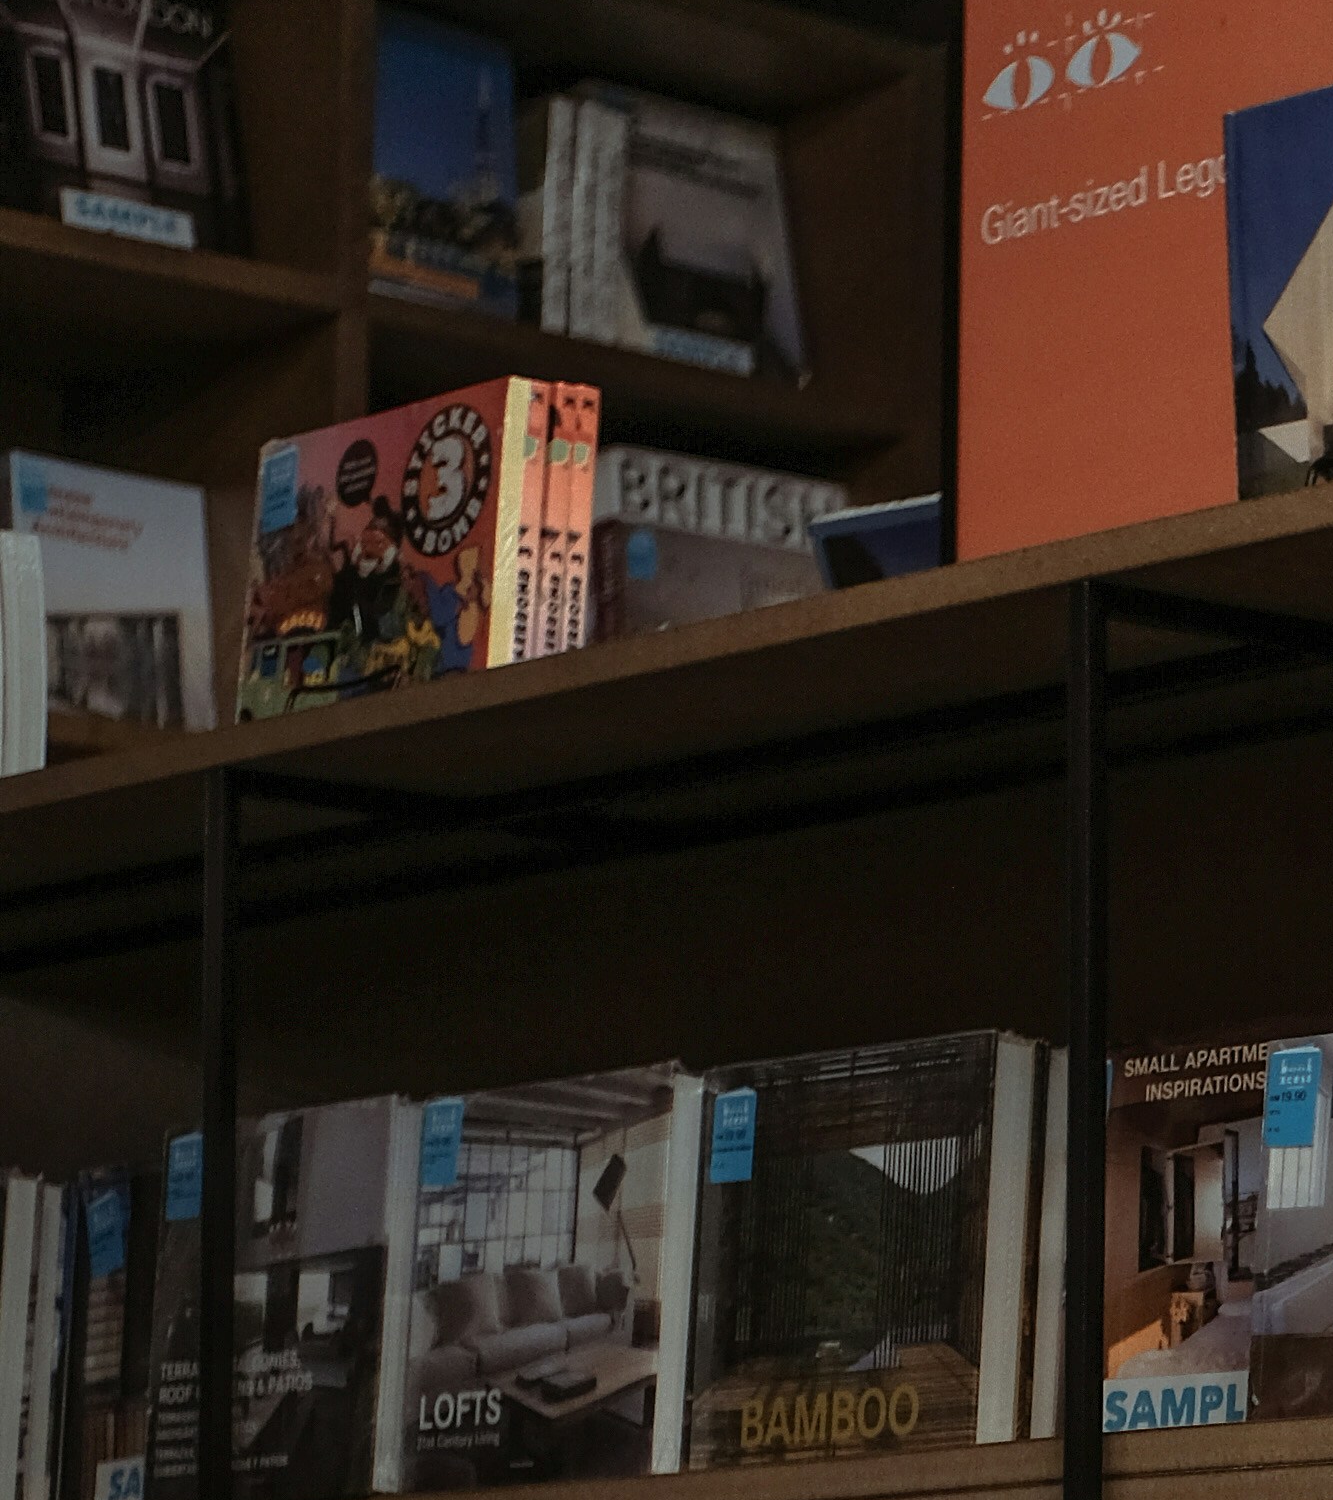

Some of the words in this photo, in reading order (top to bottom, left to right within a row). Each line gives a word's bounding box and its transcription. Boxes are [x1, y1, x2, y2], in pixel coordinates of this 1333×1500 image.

[980, 164, 1149, 245] Giant-sized
[428, 433, 465, 521] 3
[1124, 1056, 1179, 1078] SMALL
[1145, 1071, 1265, 1103] INSPIRATIONS
[419, 1389, 502, 1431] LOFTS
[740, 1383, 920, 1449] BAMBOO
